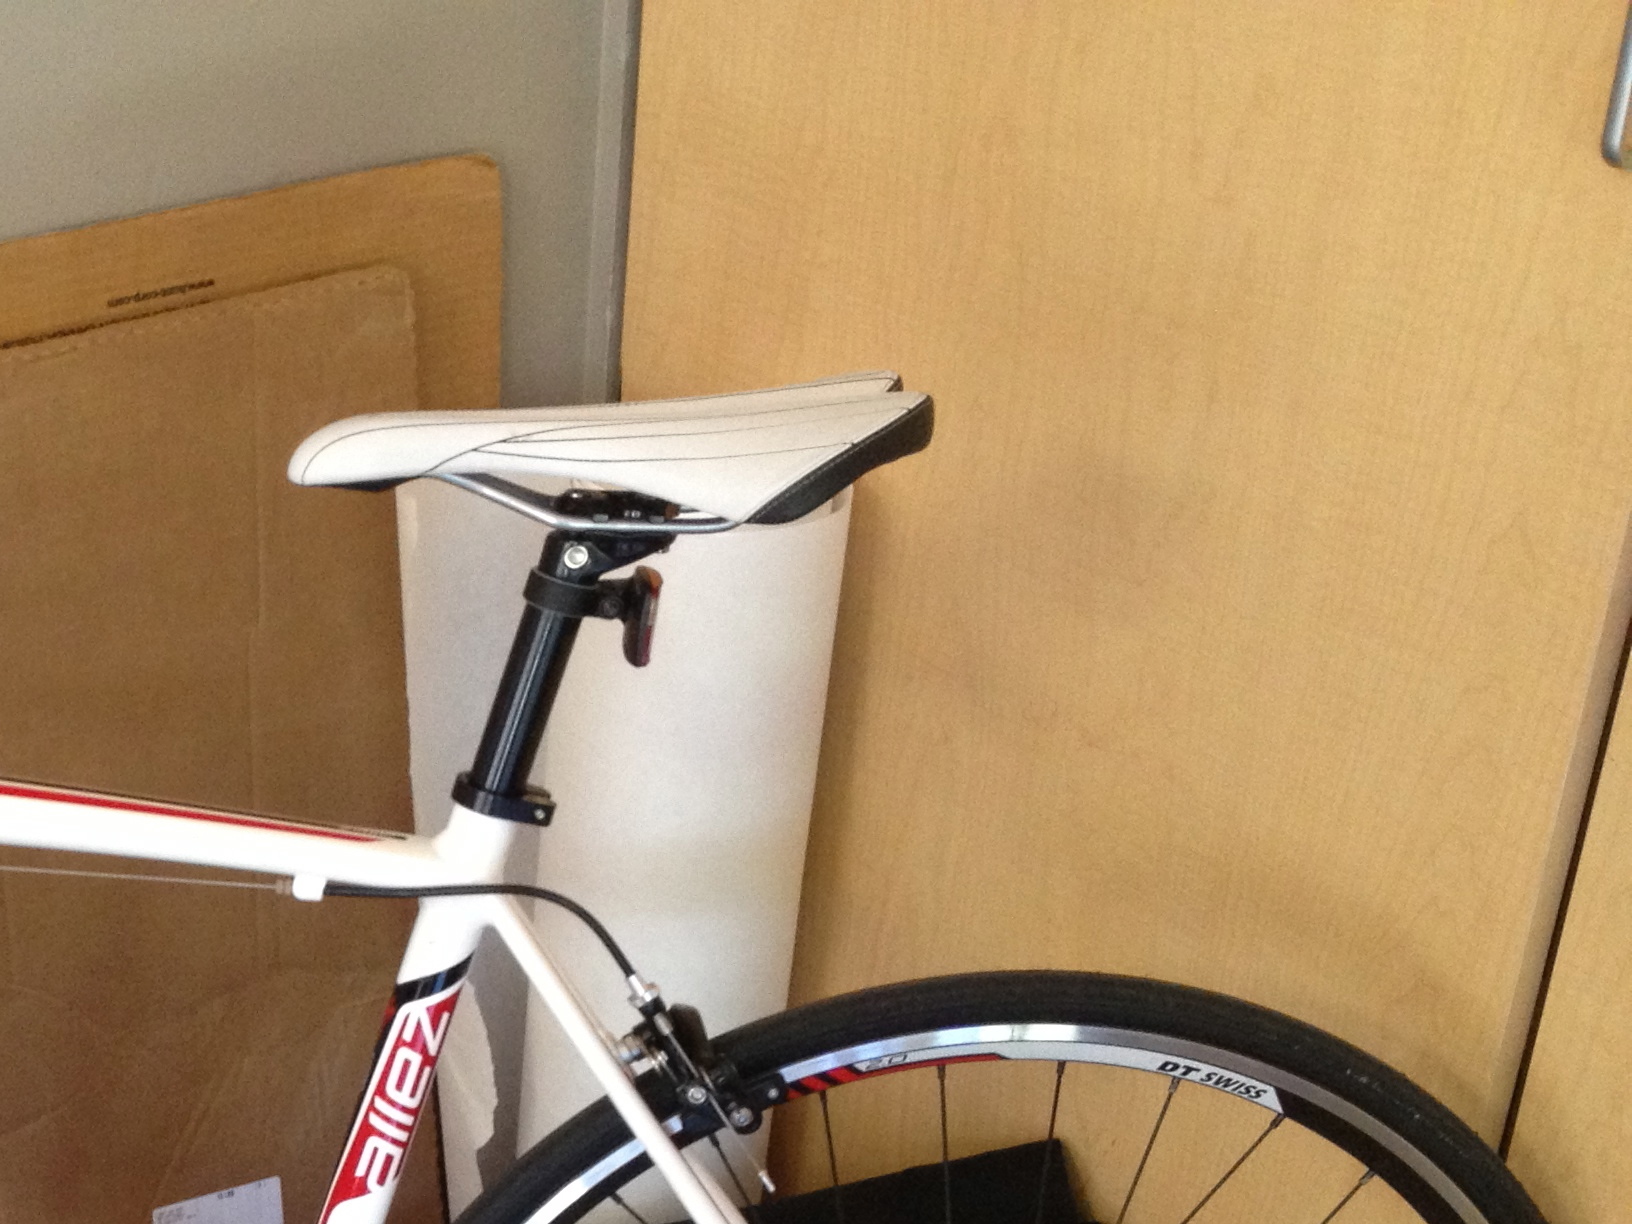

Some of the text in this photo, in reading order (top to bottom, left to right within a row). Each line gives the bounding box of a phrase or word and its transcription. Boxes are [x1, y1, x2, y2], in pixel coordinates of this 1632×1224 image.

[354, 1006, 450, 1194] allez
[1156, 1060, 1268, 1100] DT SWISS
